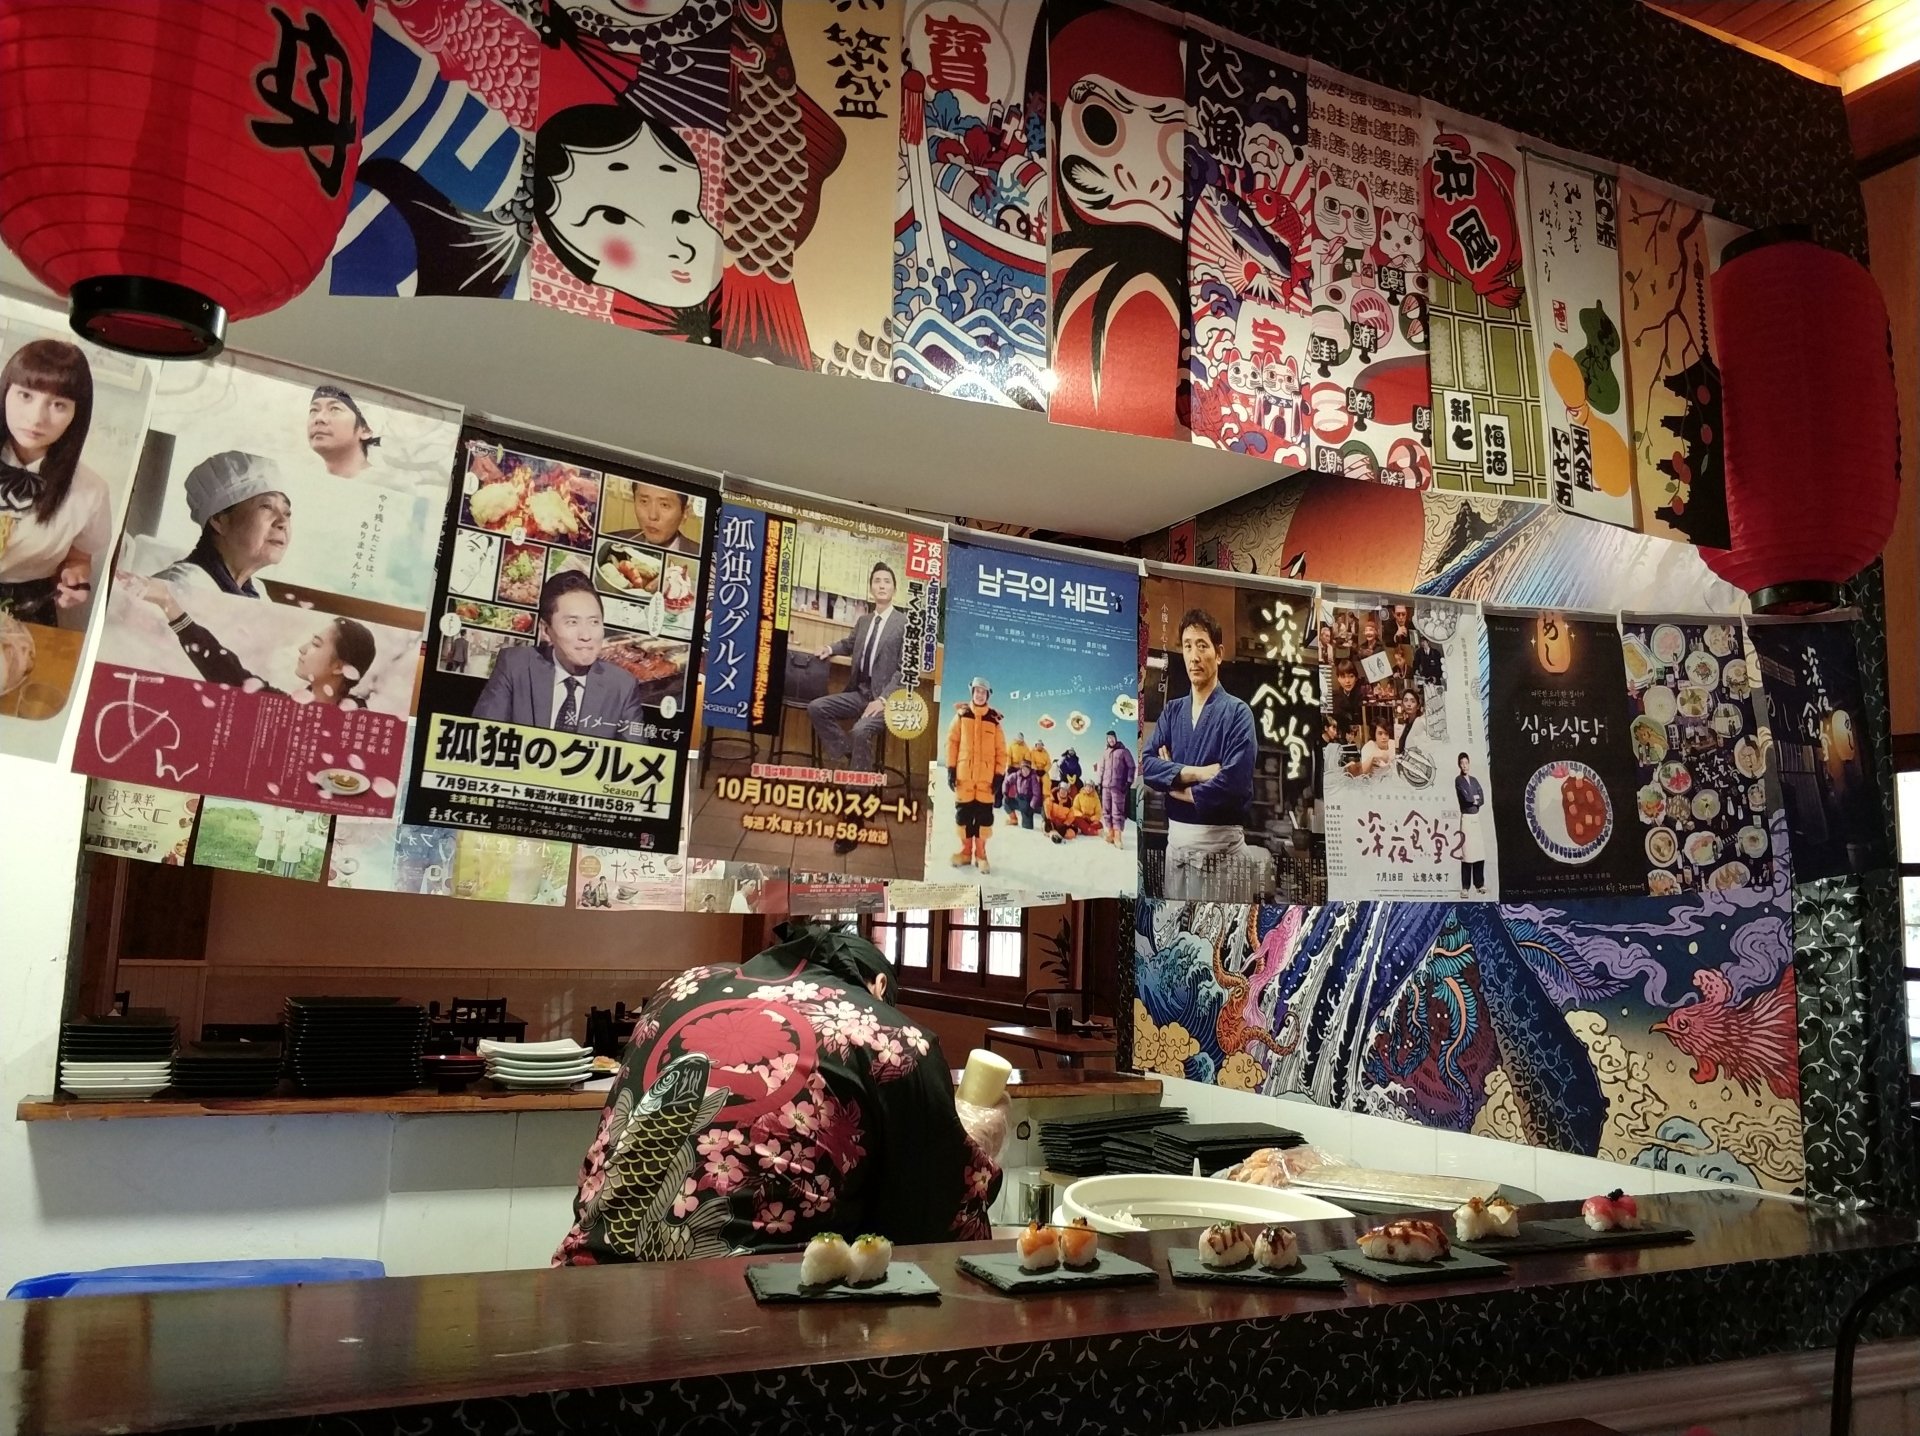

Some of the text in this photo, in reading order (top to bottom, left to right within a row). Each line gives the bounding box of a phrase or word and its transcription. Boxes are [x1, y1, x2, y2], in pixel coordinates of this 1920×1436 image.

[823, 0, 890, 119] 繁盛
[1198, 38, 1246, 167] 大漁
[1434, 151, 1499, 271] 和風
[1450, 398, 1473, 450] 新七
[1484, 423, 1507, 476] 梅酒
[911, 538, 926, 572] テロ
[925, 541, 942, 576] 夜食
[711, 515, 756, 694] 孤独のグルメ
[978, 564, 1110, 616] 남극의 쉐프
[1543, 612, 1559, 666] めし
[702, 701, 749, 719] Season 2
[1250, 601, 1320, 779] 深夜食堂
[95, 672, 199, 782] あん
[564, 711, 684, 743] ※イメージ画像です
[891, 713, 923, 731] 今秋
[1520, 714, 1605, 747] 심야식당
[436, 719, 667, 787] 孤独のグルメ
[436, 775, 520, 797] 7月9日スタート
[524, 786, 635, 813] 毎週水曜夜11時58分
[602, 784, 639, 797] Season
[641, 783, 658, 813] 4
[1376, 873, 1404, 883] 7月18日
